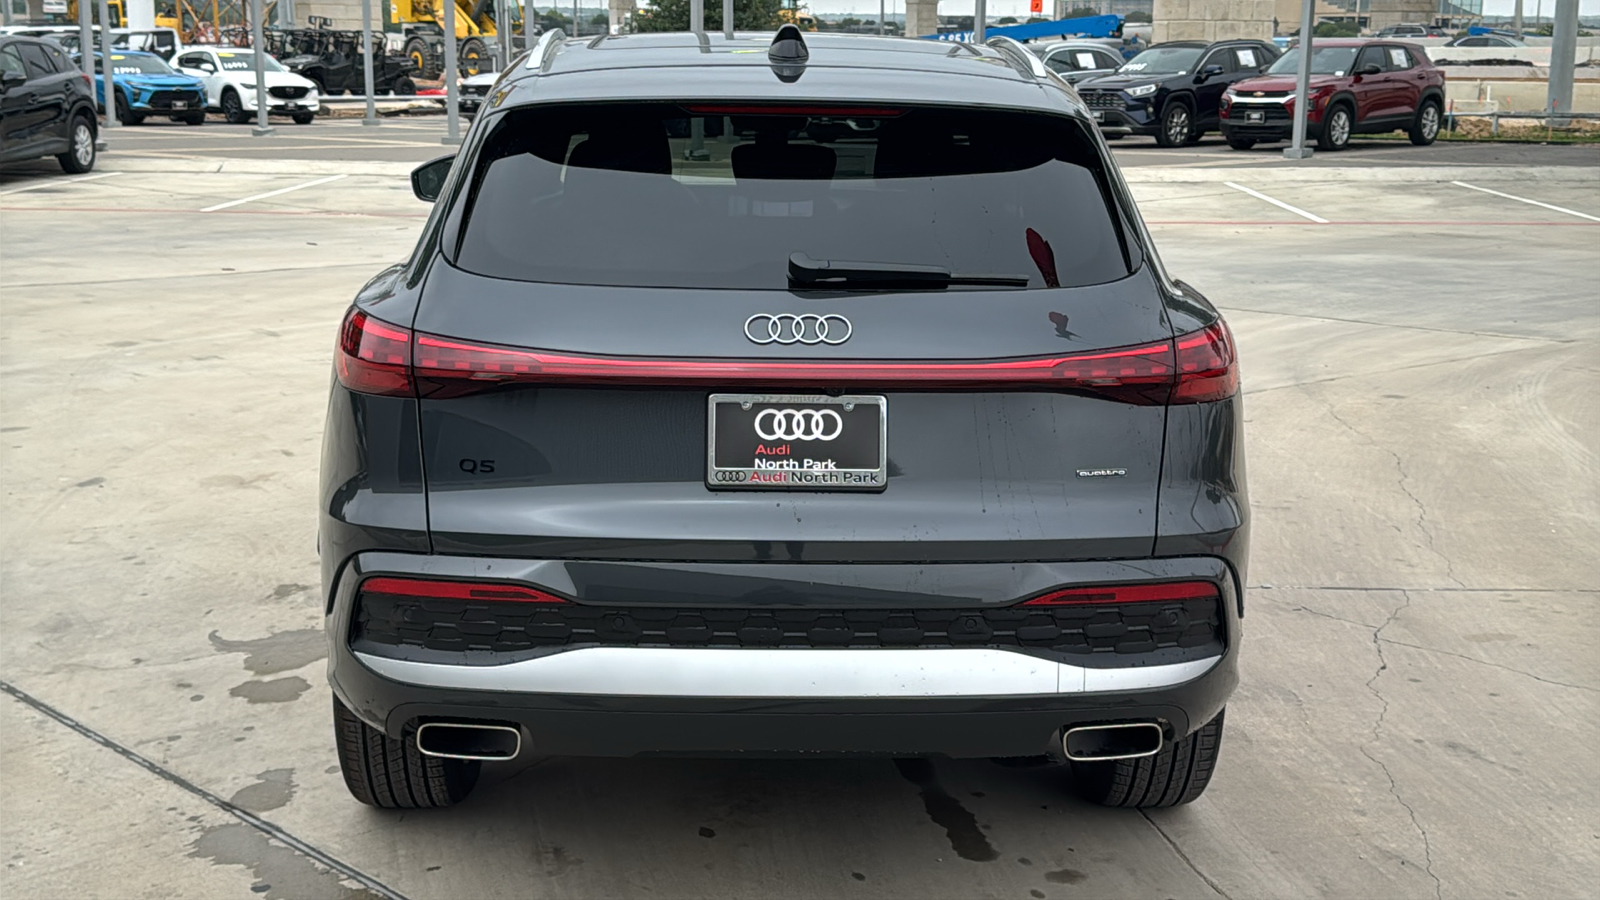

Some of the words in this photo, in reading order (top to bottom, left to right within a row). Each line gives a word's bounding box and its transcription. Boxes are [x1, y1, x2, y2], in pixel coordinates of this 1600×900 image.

[754, 443, 791, 456] Audi
[459, 458, 495, 475] Q5
[754, 458, 799, 470] North
[803, 458, 837, 470] Park
[749, 471, 787, 483] Audi
[791, 471, 839, 483] North
[843, 472, 879, 483] Park
[1078, 469, 1126, 477] quattro
